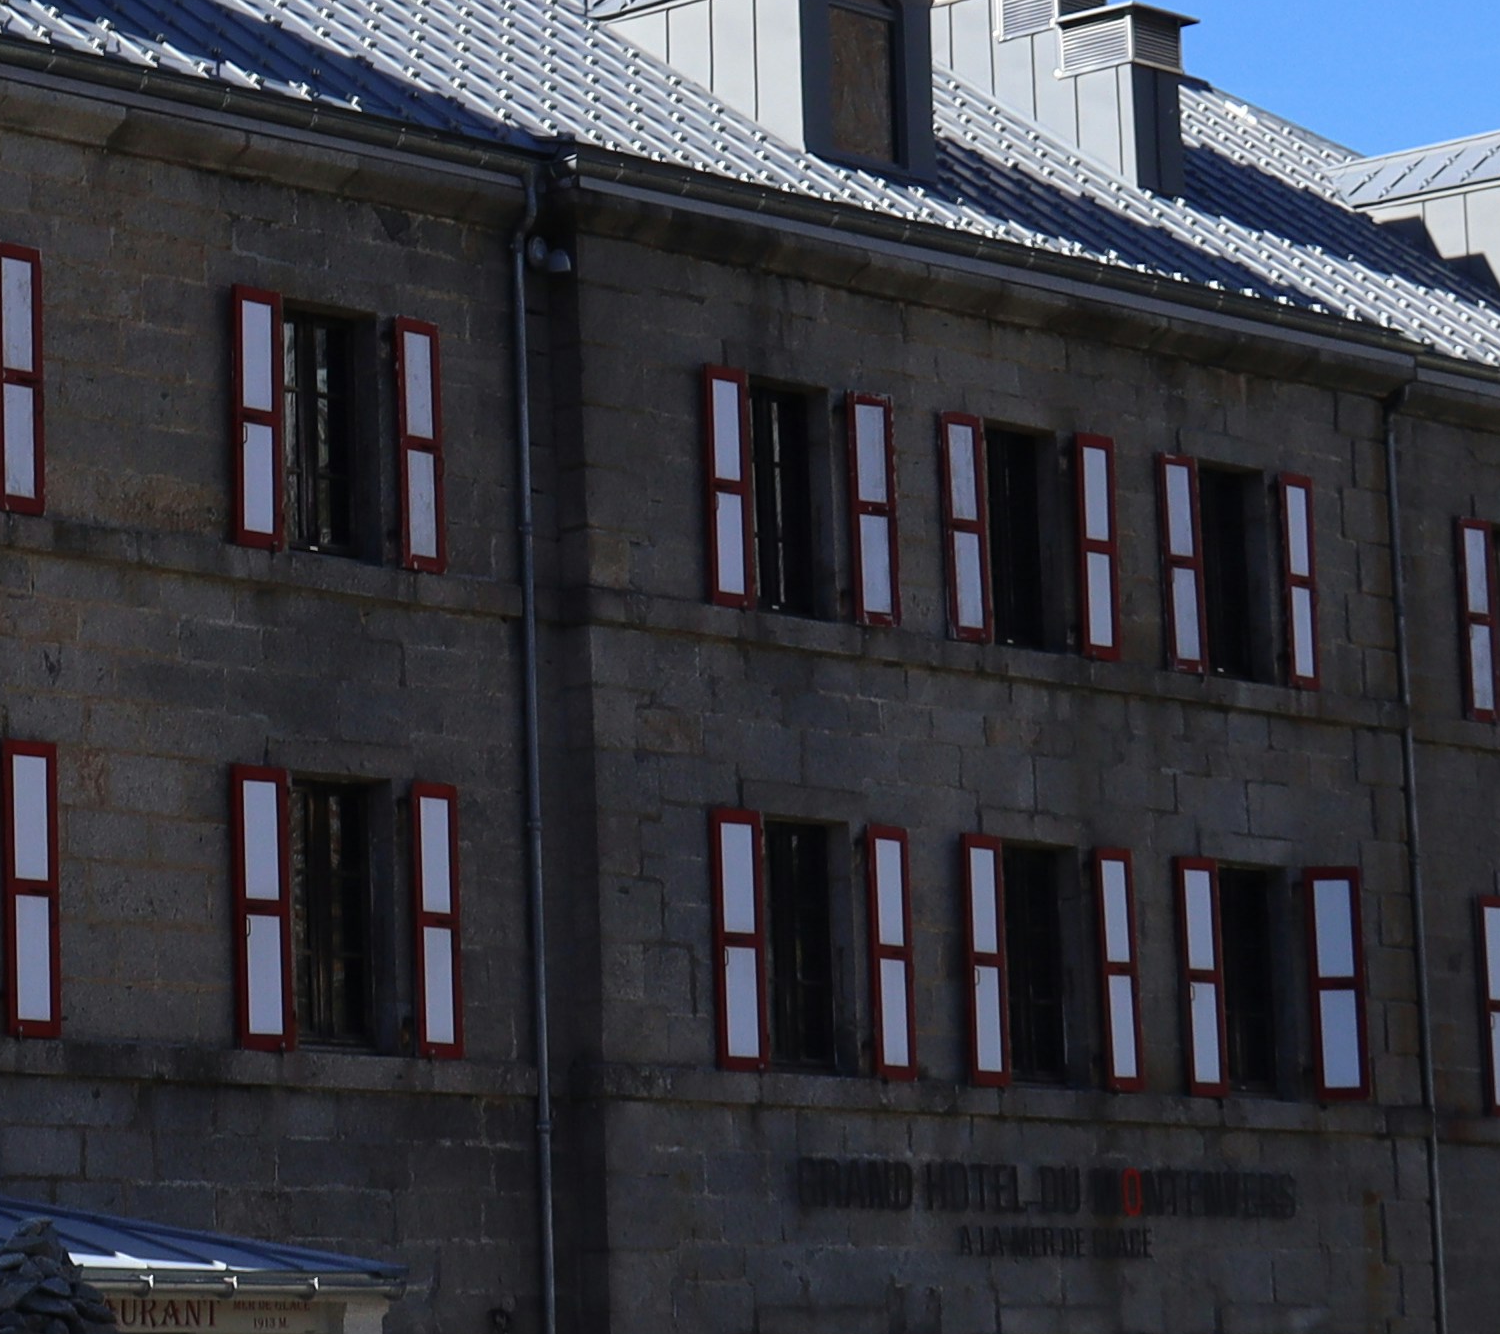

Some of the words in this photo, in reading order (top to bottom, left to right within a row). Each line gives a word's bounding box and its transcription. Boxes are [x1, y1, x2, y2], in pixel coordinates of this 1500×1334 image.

[797, 1156, 912, 1210] GRAND
[1039, 1165, 1081, 1214] DU
[1088, 1167, 1297, 1220] MONTENVERS
[1011, 1227, 1054, 1257] MER
[1060, 1227, 1085, 1258] DE
[104, 1298, 220, 1327] AURANT
[233, 1300, 255, 1311] MER
[258, 1300, 271, 1311] DE
[253, 1317, 275, 1329] 1913
